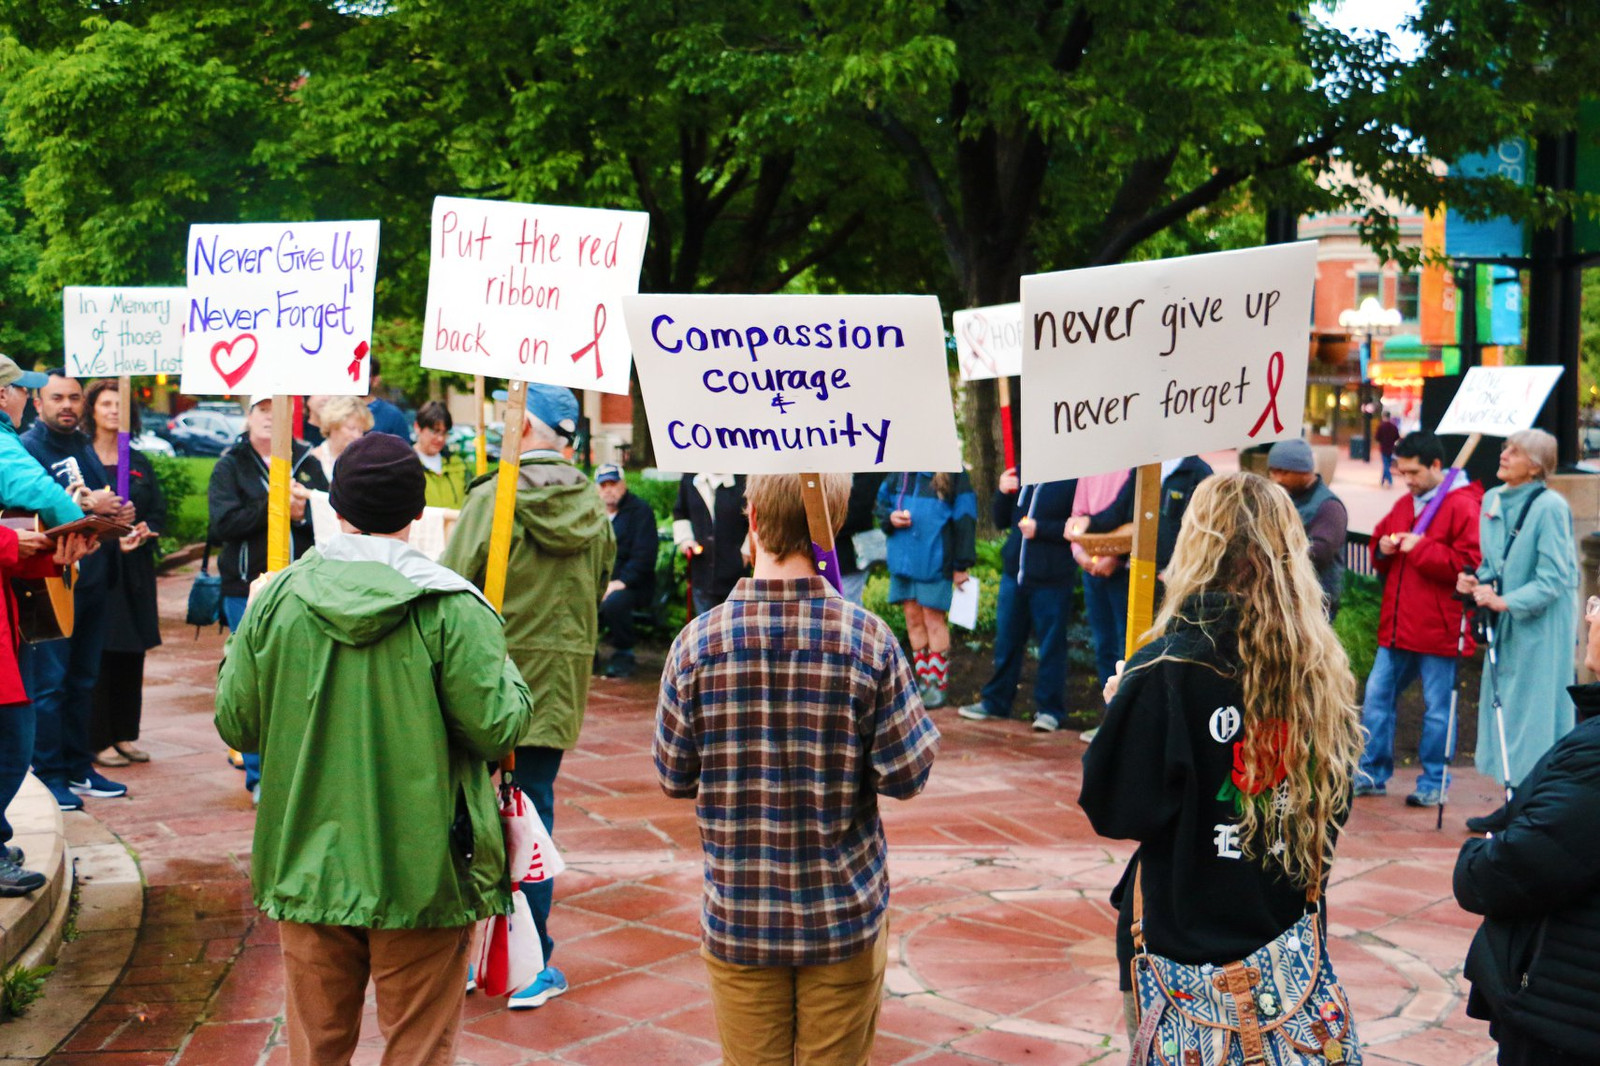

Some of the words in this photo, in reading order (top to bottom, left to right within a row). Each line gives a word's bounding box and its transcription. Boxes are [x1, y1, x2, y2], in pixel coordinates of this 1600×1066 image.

[194, 234, 273, 276] Never
[276, 230, 325, 273] Give
[332, 231, 364, 293] Up,
[441, 210, 492, 261] Put
[515, 219, 561, 264] the
[578, 221, 623, 269] red
[79, 292, 98, 315] In
[109, 292, 170, 325] Memory
[485, 266, 560, 310] ribbon
[92, 318, 109, 347] of
[117, 320, 162, 347] those
[189, 297, 270, 333] Never
[276, 284, 354, 355] Forget
[435, 307, 490, 357] back
[518, 337, 548, 365] on
[651, 314, 905, 362] Compassion
[1034, 299, 1145, 350] never
[1159, 296, 1223, 357] give
[1245, 290, 1281, 326] up
[72, 346, 109, 375] We
[113, 349, 147, 374] Have
[154, 345, 183, 372] Lost
[702, 368, 851, 401] courage
[1053, 392, 1140, 434] never
[1159, 366, 1250, 424] forget
[667, 412, 891, 465] community
